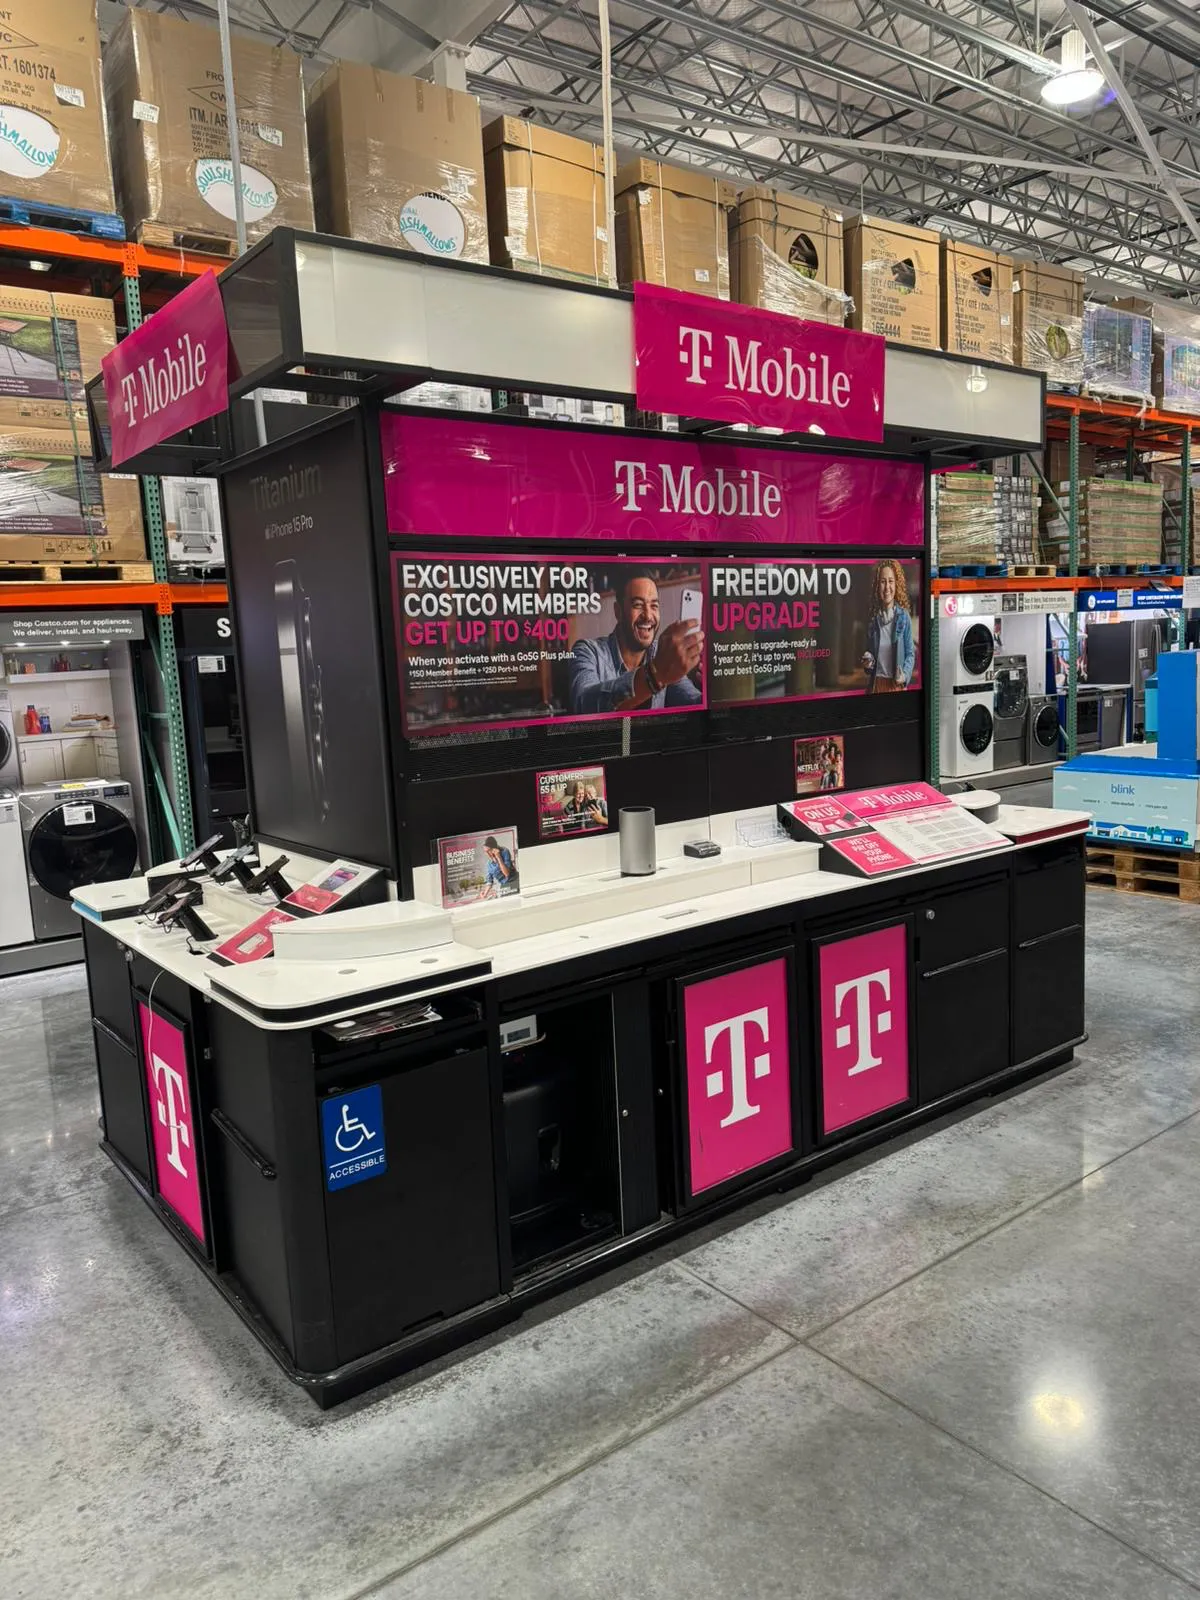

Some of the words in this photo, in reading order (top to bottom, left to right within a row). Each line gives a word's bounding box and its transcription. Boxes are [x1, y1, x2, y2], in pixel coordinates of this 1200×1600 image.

[13, 58, 56, 83] 1601374
[138, 333, 206, 419] Mobile
[725, 335, 850, 408] Mobile
[249, 464, 322, 514] Titanium
[658, 464, 781, 518] Mobile
[292, 516, 301, 532] 15
[301, 514, 314, 531] Pro
[402, 565, 544, 589] EXCLUSIVELY
[550, 567, 588, 589] FOR
[712, 567, 818, 597] FREEDOM
[823, 568, 851, 595] TO
[404, 593, 497, 617] COSTCO
[503, 592, 601, 616] MEMBERS
[13, 620, 33, 628] Shop
[34, 619, 79, 627] Costco.com
[93, 618, 133, 627] appliances.
[712, 602, 820, 632] UPGRADE
[97, 627, 134, 636] haul-away.
[406, 621, 449, 645] GET
[456, 620, 486, 645] UP
[490, 620, 519, 643] TO
[524, 618, 570, 641] $400
[713, 642, 729, 652] Your
[730, 641, 752, 653] phone
[753, 641, 759, 650] is
[760, 639, 809, 651] upgrade-ready
[810, 639, 817, 647] in
[409, 656, 435, 666] When
[437, 656, 453, 668] you
[455, 655, 489, 665] activate
[491, 653, 509, 662] with
[540, 651, 557, 660] Plus
[558, 650, 577, 662] plan.
[718, 655, 733, 666] year
[735, 655, 743, 663] or
[744, 655, 751, 664] 2,
[752, 652, 762, 662] it's
[763, 654, 773, 664] up
[774, 652, 781, 661] to
[782, 652, 796, 664] you,
[425, 667, 453, 677] Member
[454, 666, 477, 676] Benefit
[519, 664, 538, 672] Credit
[713, 668, 722, 676] on
[723, 667, 735, 676] our
[736, 664, 752, 674] best
[773, 662, 792, 674] plans
[540, 772, 584, 785] CUSTOMERS
[556, 783, 568, 792] UP
[1111, 783, 1135, 795] blink
[878, 790, 928, 807] Mobile
[804, 809, 823, 820] ON
[823, 807, 841, 816] US
[329, 1154, 385, 1181] ACCESSIBLE
